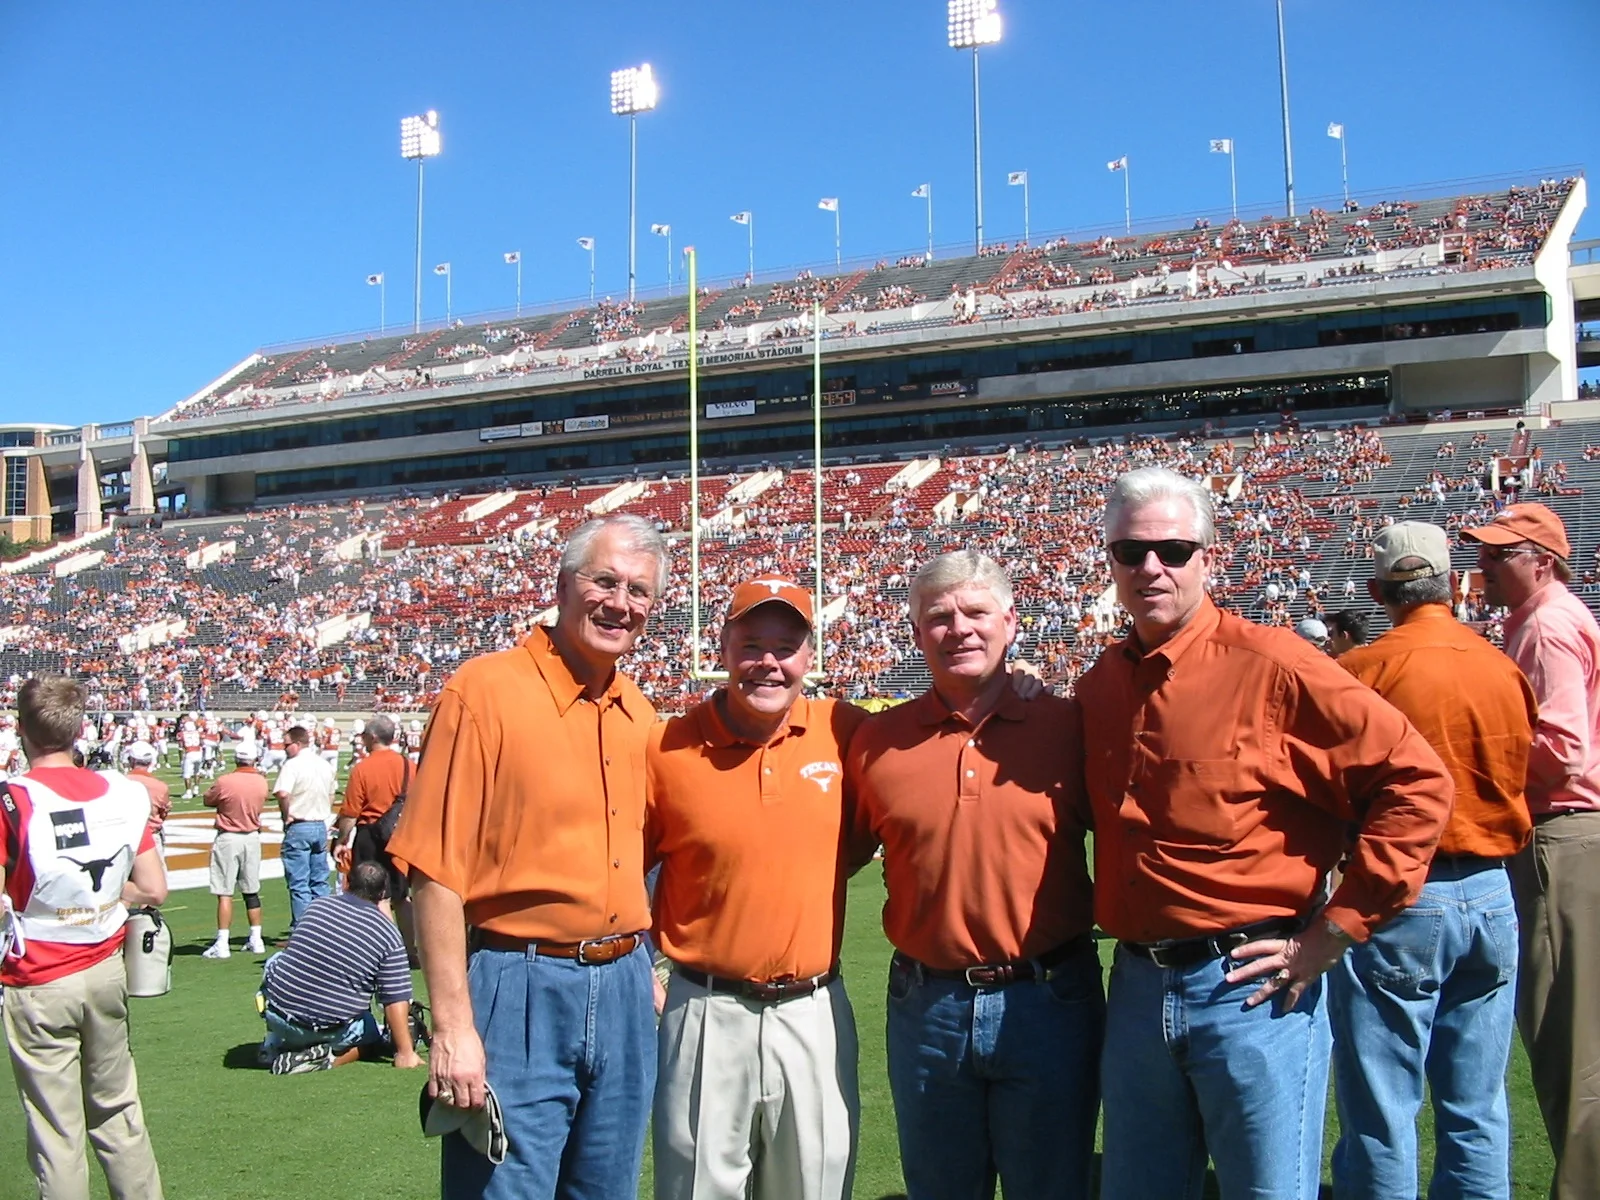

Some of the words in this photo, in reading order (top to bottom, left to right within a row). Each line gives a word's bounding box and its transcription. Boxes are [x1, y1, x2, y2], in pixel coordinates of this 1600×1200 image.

[583, 367, 623, 379] DARRELL
[625, 365, 632, 374] K
[635, 362, 663, 372] ROYAL
[672, 357, 704, 369] TEXS
[706, 351, 756, 365] MEMORIAL
[758, 345, 803, 358] STADIUM
[799, 761, 840, 778] TEXAS
